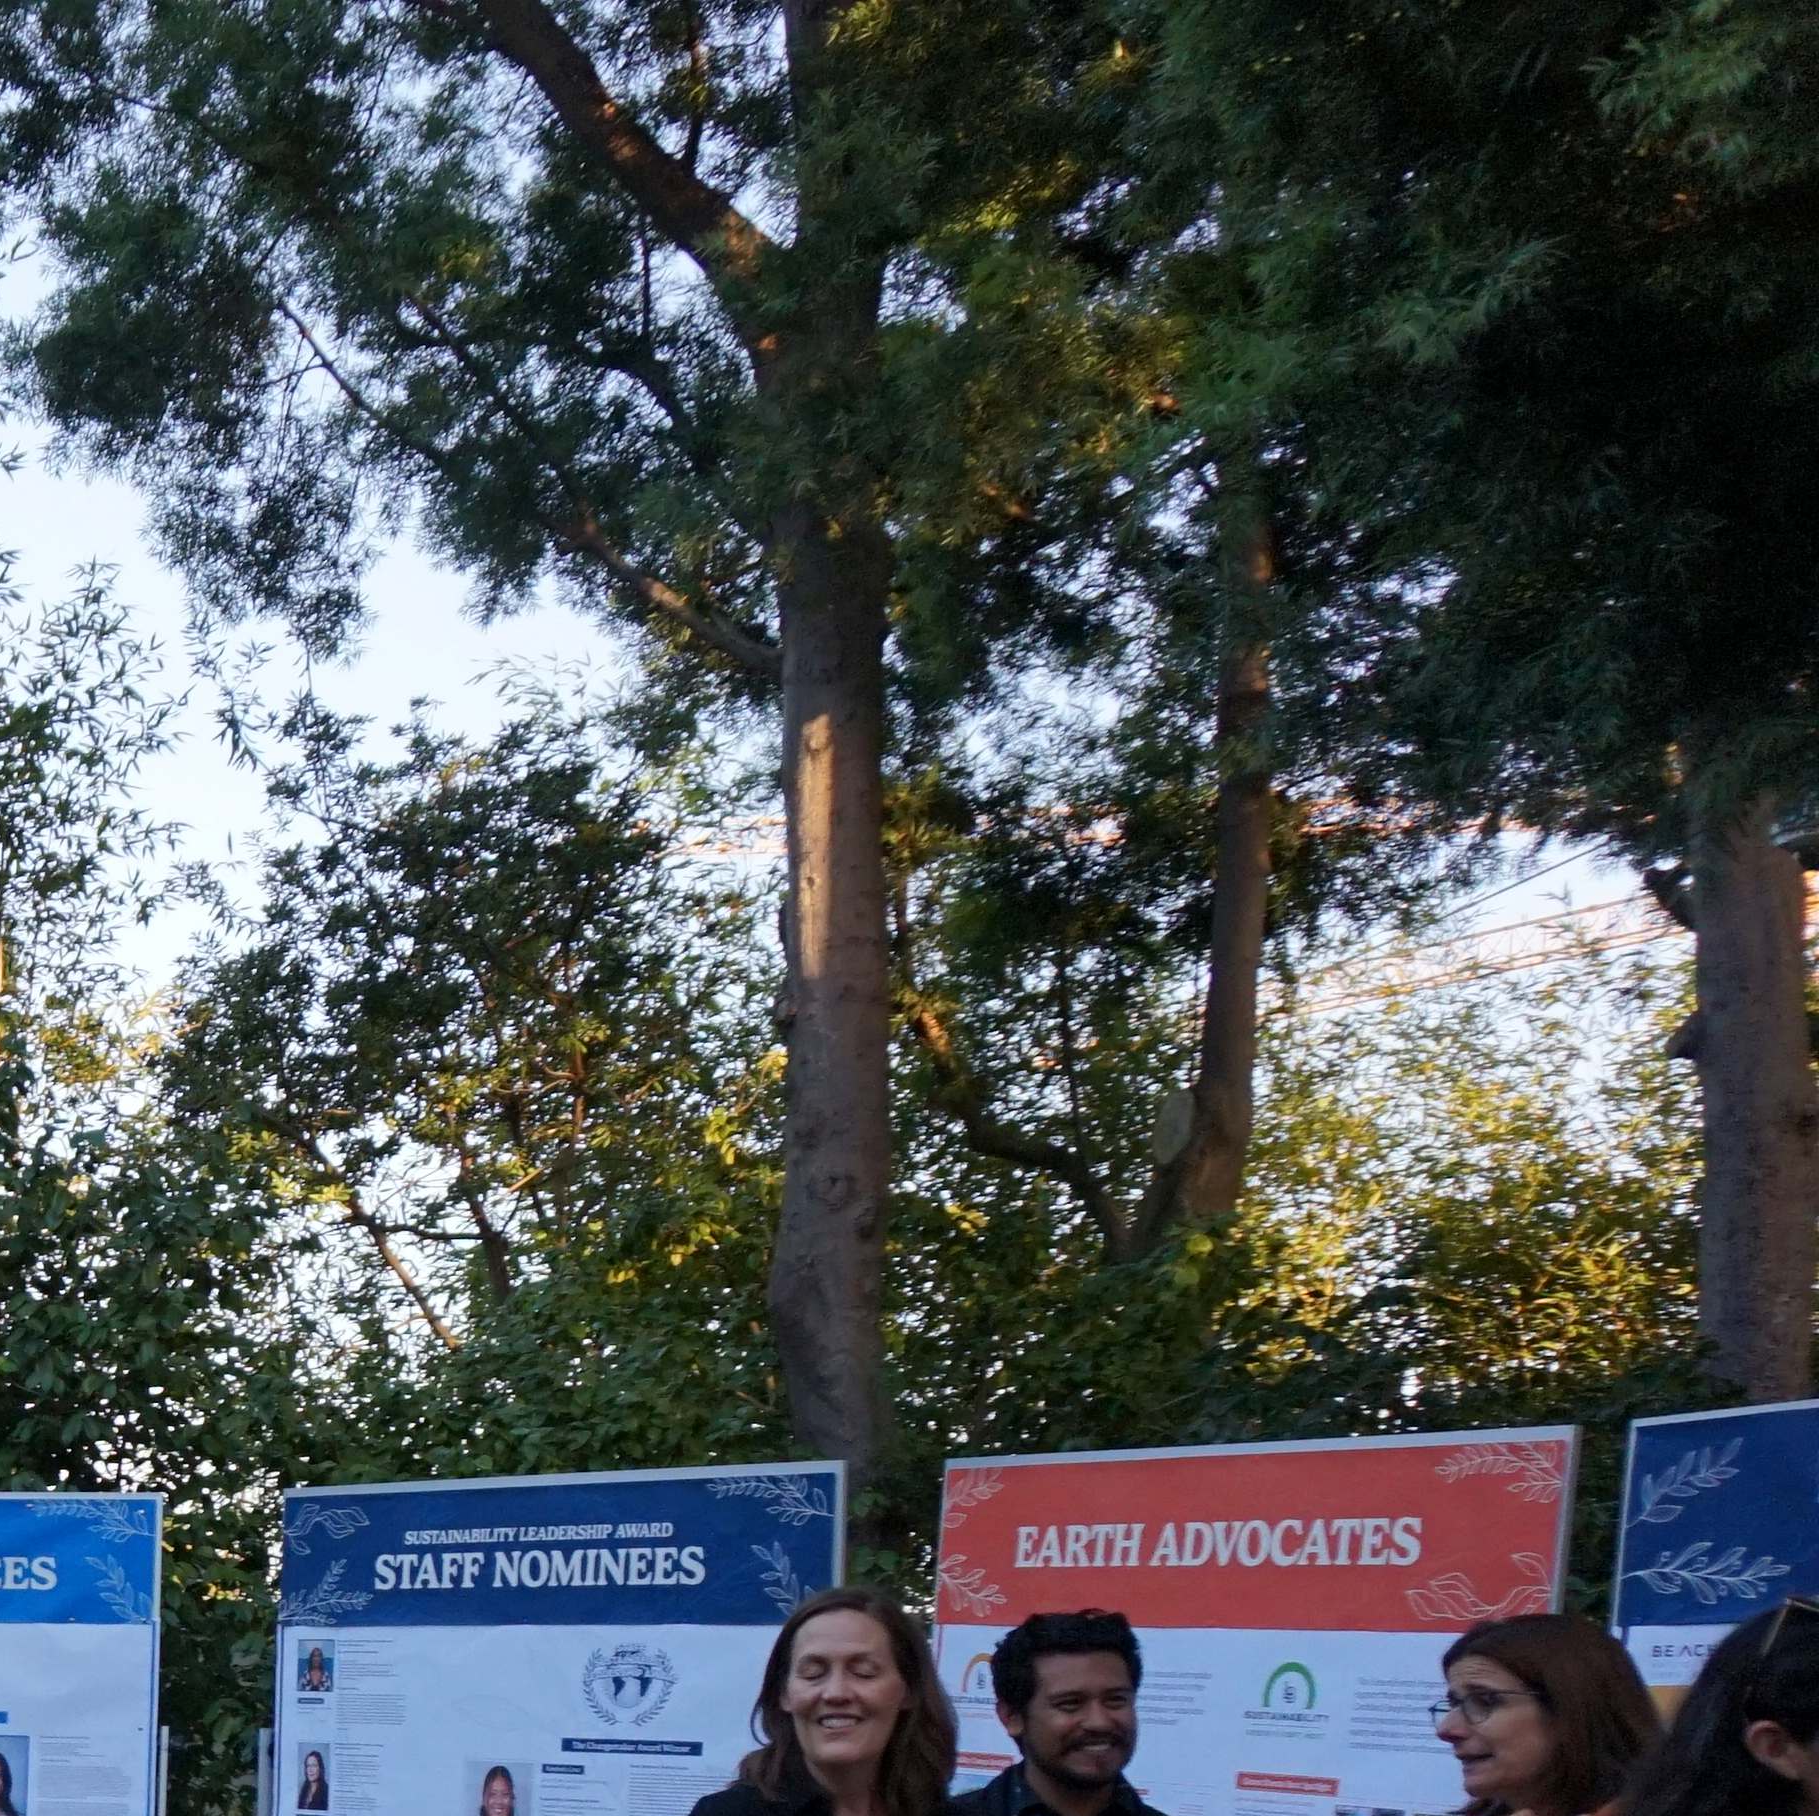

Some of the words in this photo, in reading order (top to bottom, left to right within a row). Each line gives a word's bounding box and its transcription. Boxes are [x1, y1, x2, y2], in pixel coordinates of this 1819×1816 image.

[404, 1528, 518, 1546] SUSTAINABILITY
[518, 1524, 612, 1542] LEADERSHIP
[615, 1522, 674, 1540] AWARD
[1014, 1523, 1145, 1568] EARTH
[1148, 1516, 1423, 1567] ADVOCATES
[374, 1552, 485, 1590] STAFF
[492, 1546, 706, 1588] NOMINEES
